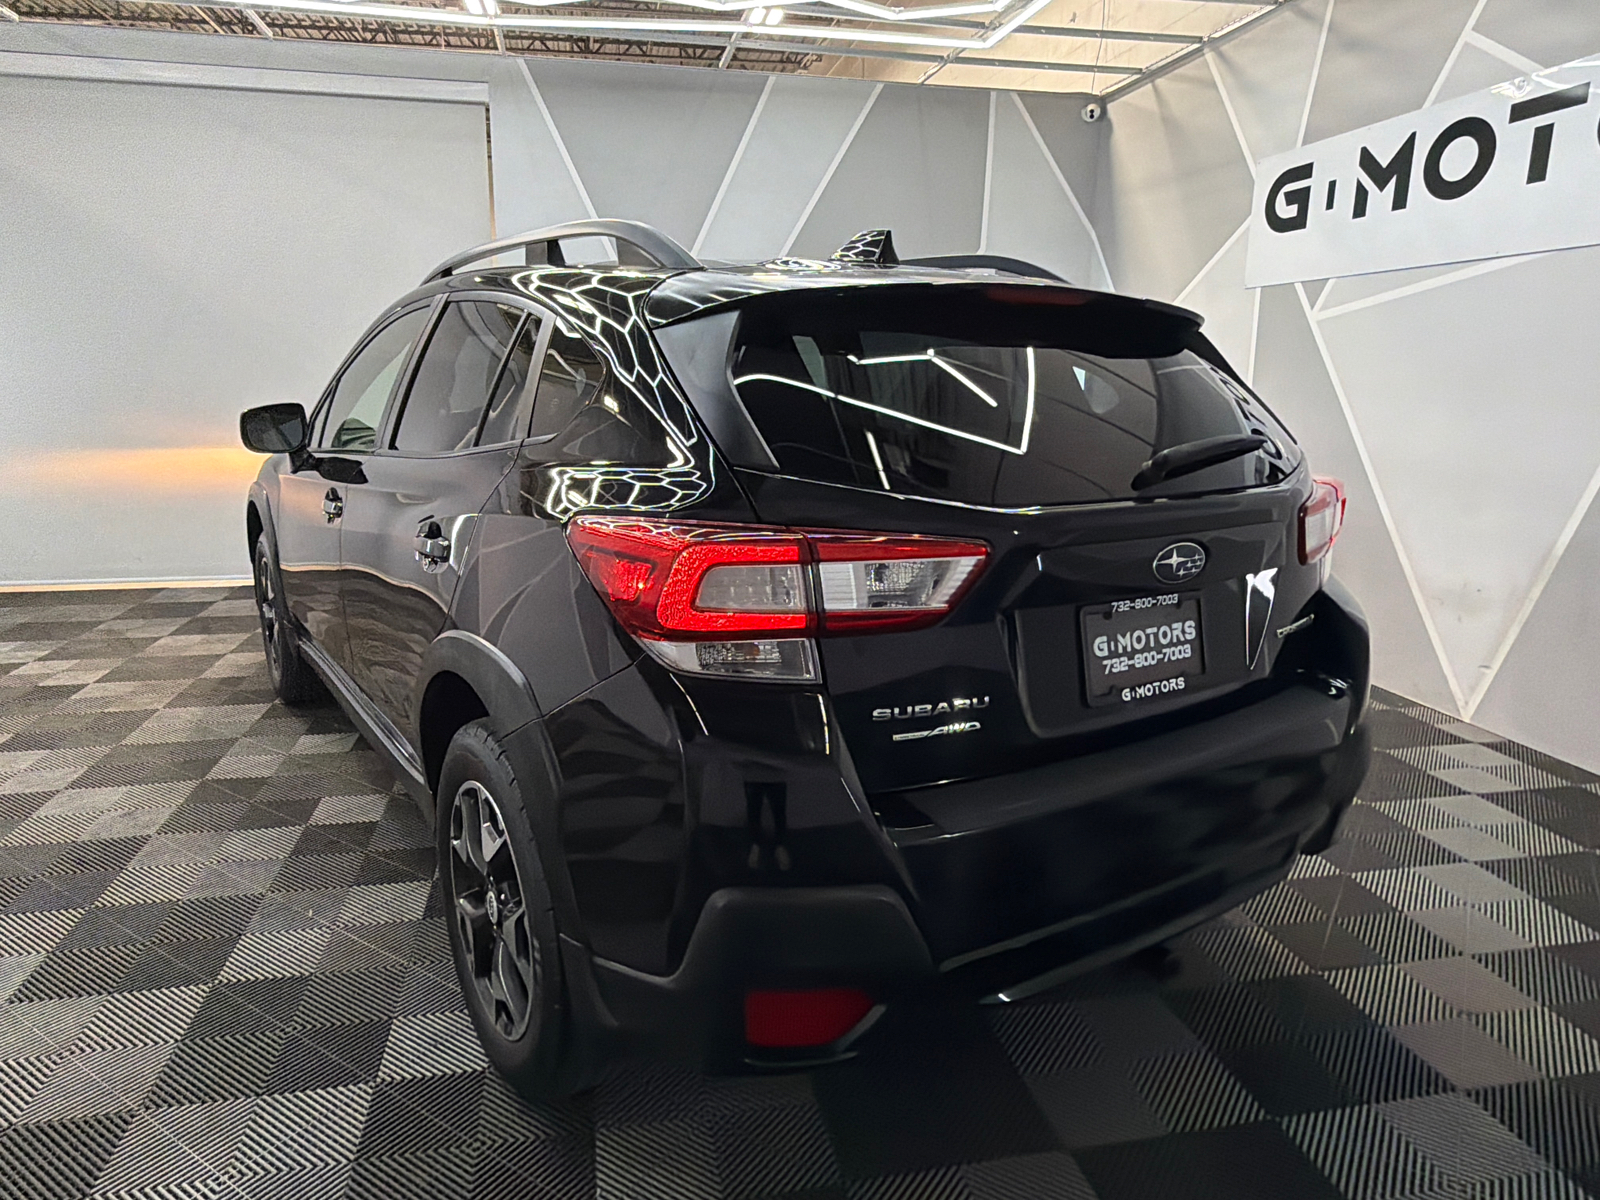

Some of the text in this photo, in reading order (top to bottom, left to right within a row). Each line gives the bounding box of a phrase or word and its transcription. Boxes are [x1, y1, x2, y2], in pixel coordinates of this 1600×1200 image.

[1111, 593, 1178, 613] 732-800-7003
[1102, 643, 1192, 675] 732-800-7003
[872, 695, 990, 721] SUBARU
